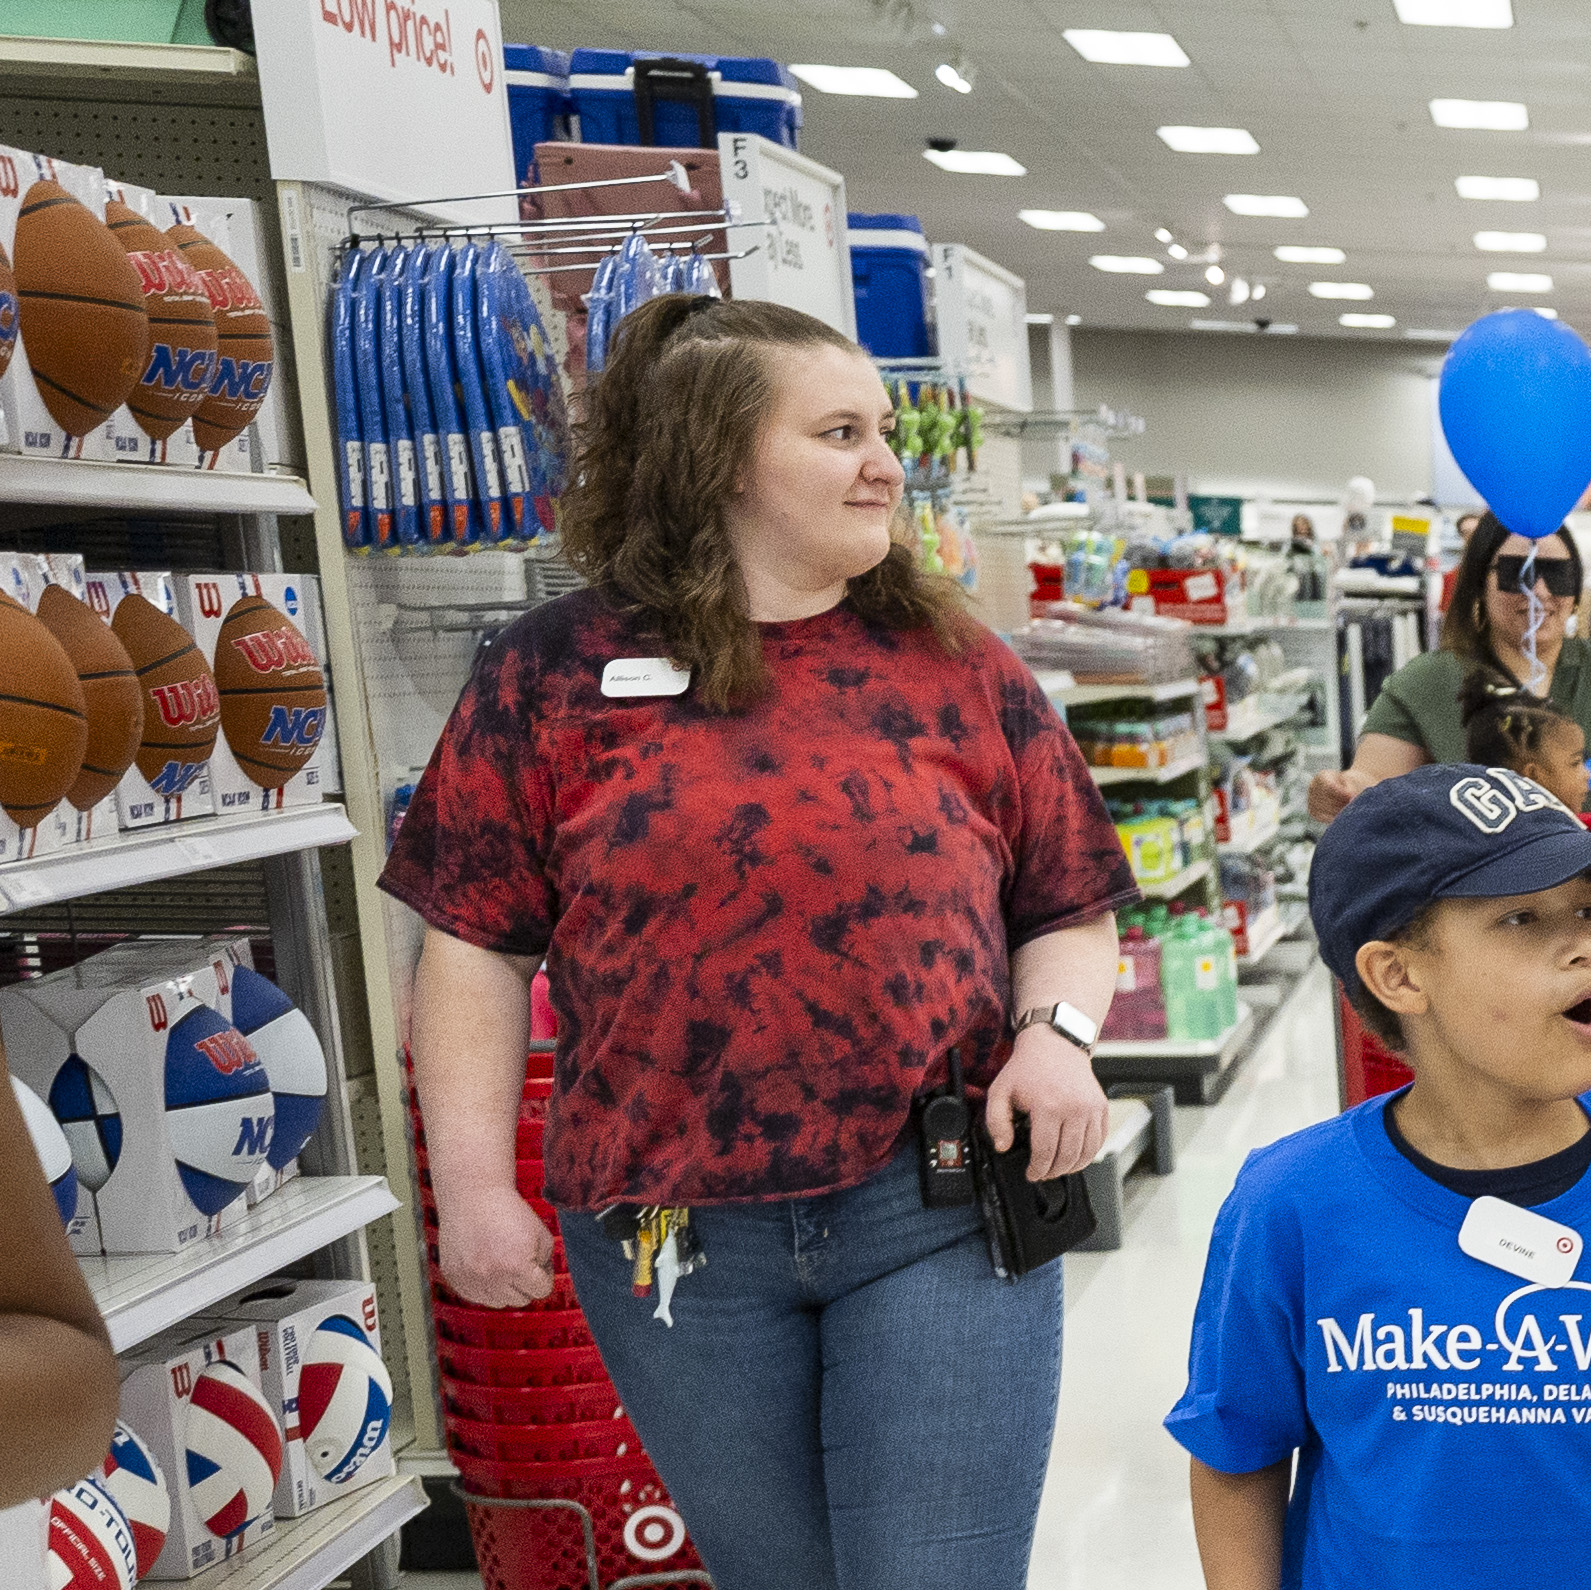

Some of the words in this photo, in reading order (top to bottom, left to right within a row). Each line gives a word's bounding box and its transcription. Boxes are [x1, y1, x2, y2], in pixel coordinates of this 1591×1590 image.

[385, 0, 456, 77] price!
[732, 138, 746, 157] F
[733, 160, 749, 180] 3
[1449, 767, 1589, 835] GA
[1498, 1238, 1538, 1261] DEVINE
[1386, 1382, 1539, 1403] PHILADELPHIA,
[1392, 1406, 1408, 1422] &
[1412, 1404, 1568, 1426] SUSQUEHANNA
